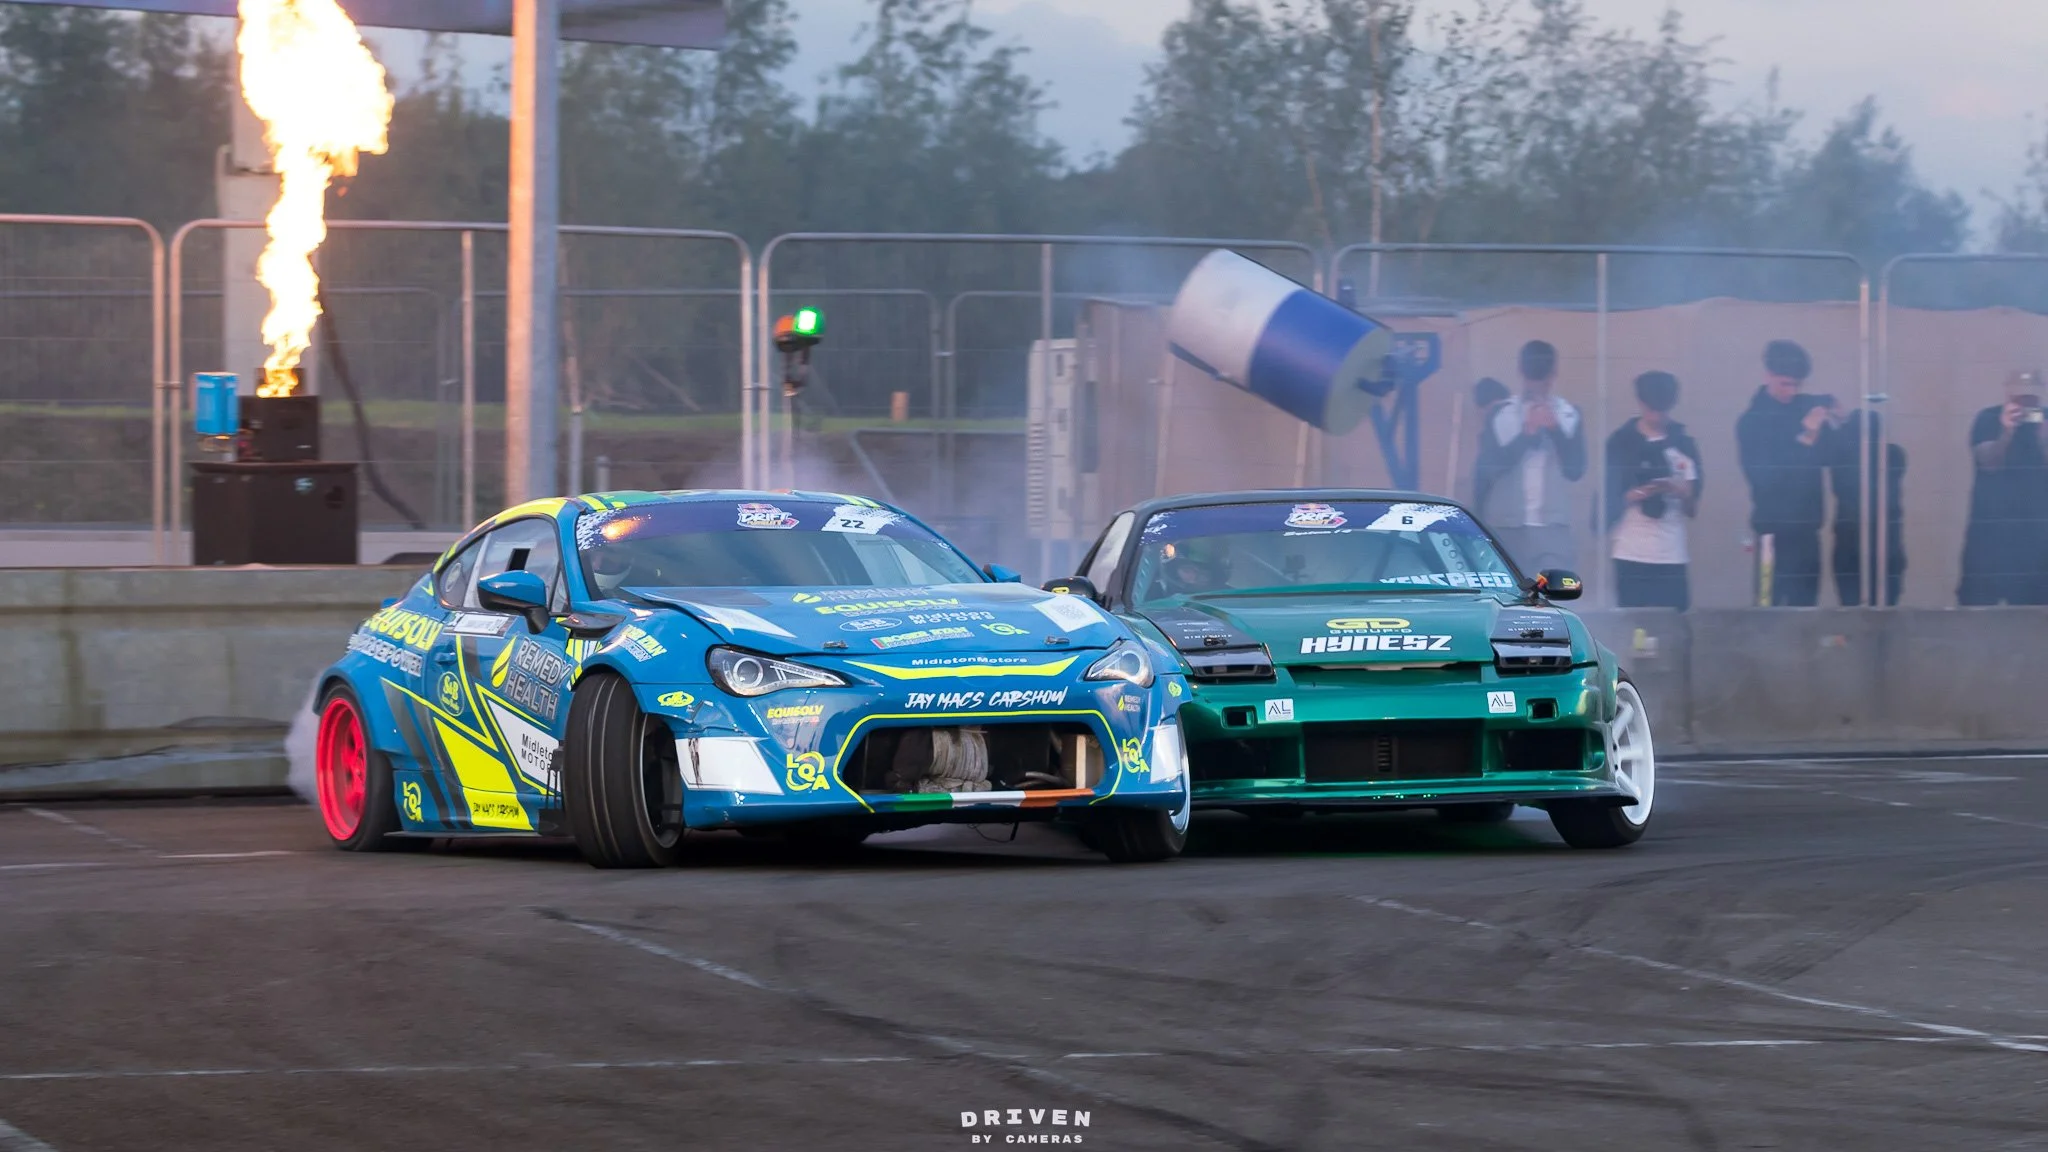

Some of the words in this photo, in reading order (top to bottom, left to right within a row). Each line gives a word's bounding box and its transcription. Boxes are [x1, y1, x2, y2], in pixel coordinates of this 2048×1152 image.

[741, 512, 792, 522] DRIFT
[1290, 512, 1344, 522] DRIFT
[1402, 516, 1413, 525] 6
[840, 518, 866, 529] 22
[908, 611, 991, 622] Midleton
[913, 617, 996, 625] MOTORS
[514, 635, 574, 687] REMEDY
[911, 656, 1028, 666] MidletonMotors
[503, 666, 560, 721] HEALTH
[904, 692, 936, 710] JAY
[936, 690, 985, 709] MACS
[988, 686, 1069, 707] CARSHOW
[767, 705, 825, 719] EQUISOLV
[521, 733, 554, 761] Midleto
